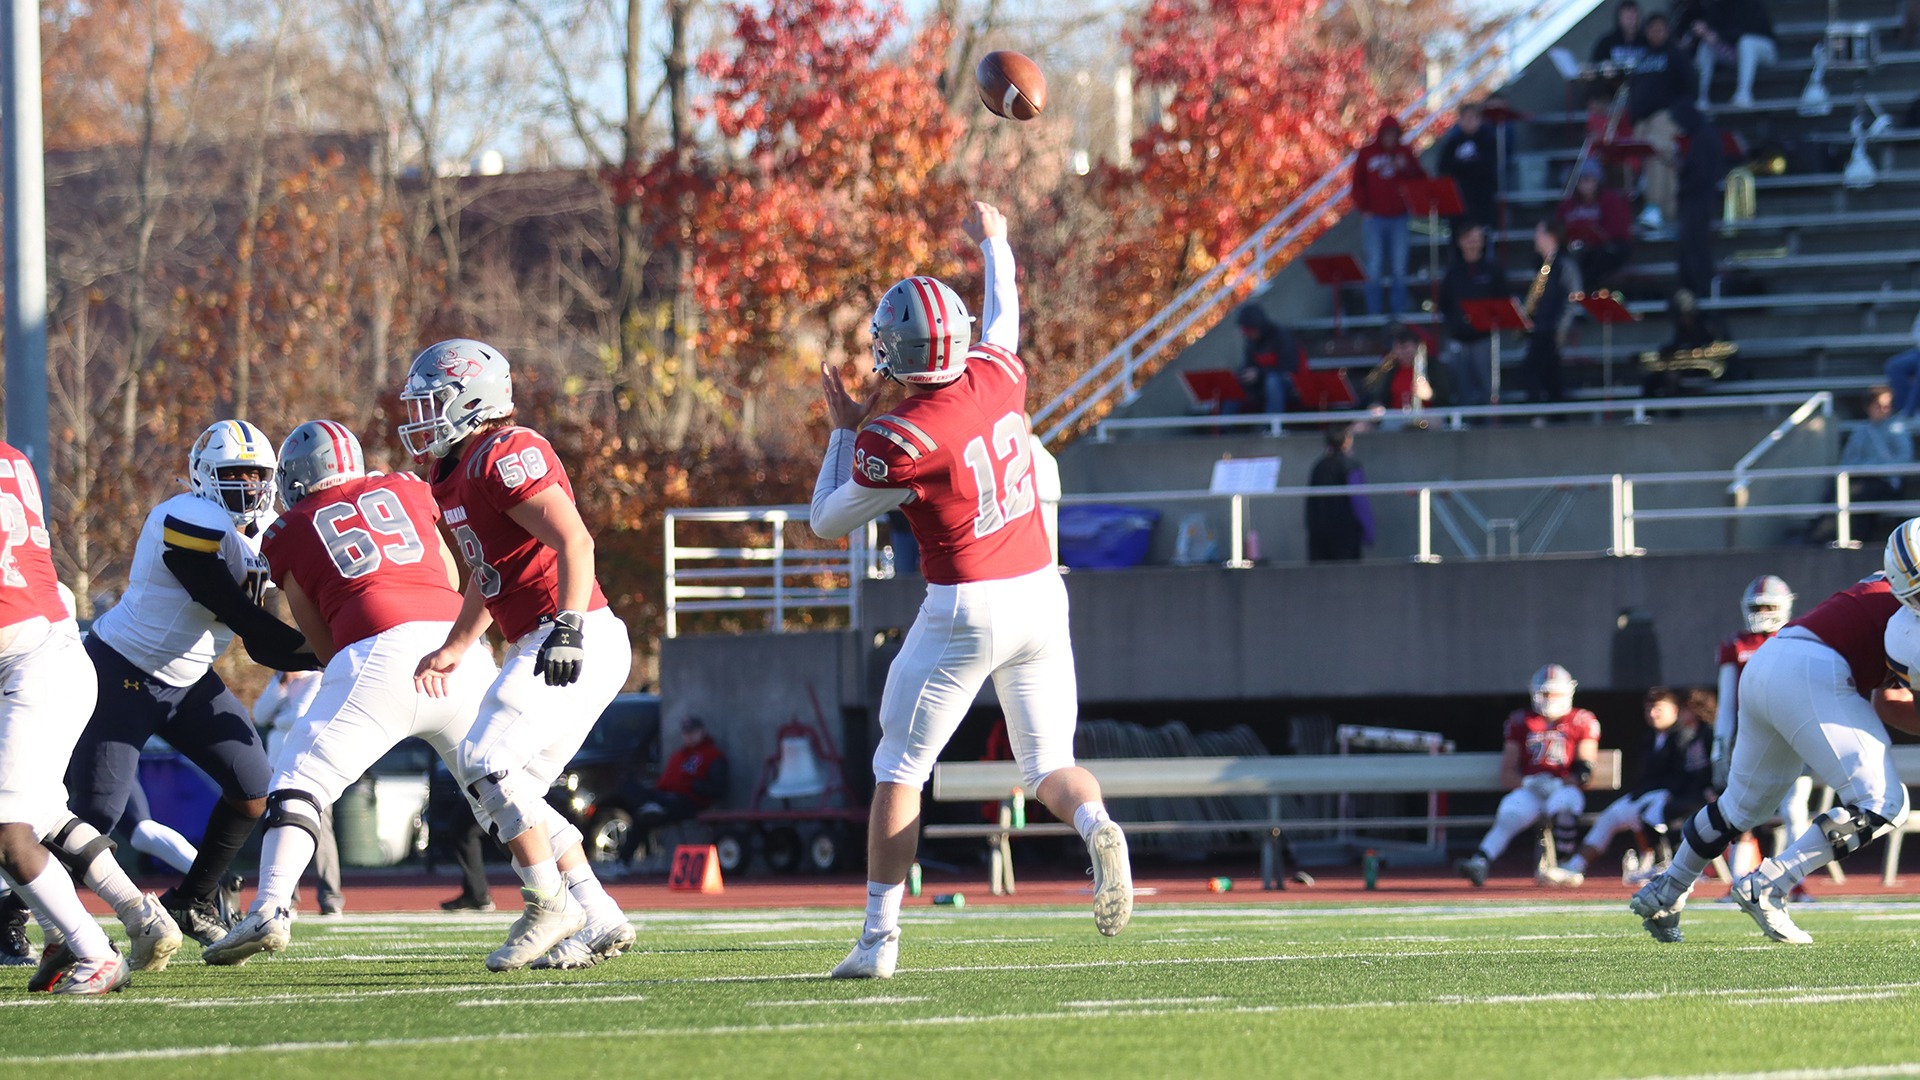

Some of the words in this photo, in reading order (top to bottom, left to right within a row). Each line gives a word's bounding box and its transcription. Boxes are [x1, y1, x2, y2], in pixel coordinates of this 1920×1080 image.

[495, 446, 548, 489] 58
[856, 448, 889, 482] 12
[963, 410, 1036, 539] 12
[312, 487, 425, 579] 69
[450, 524, 502, 599] 8
[674, 853, 705, 885] 30
